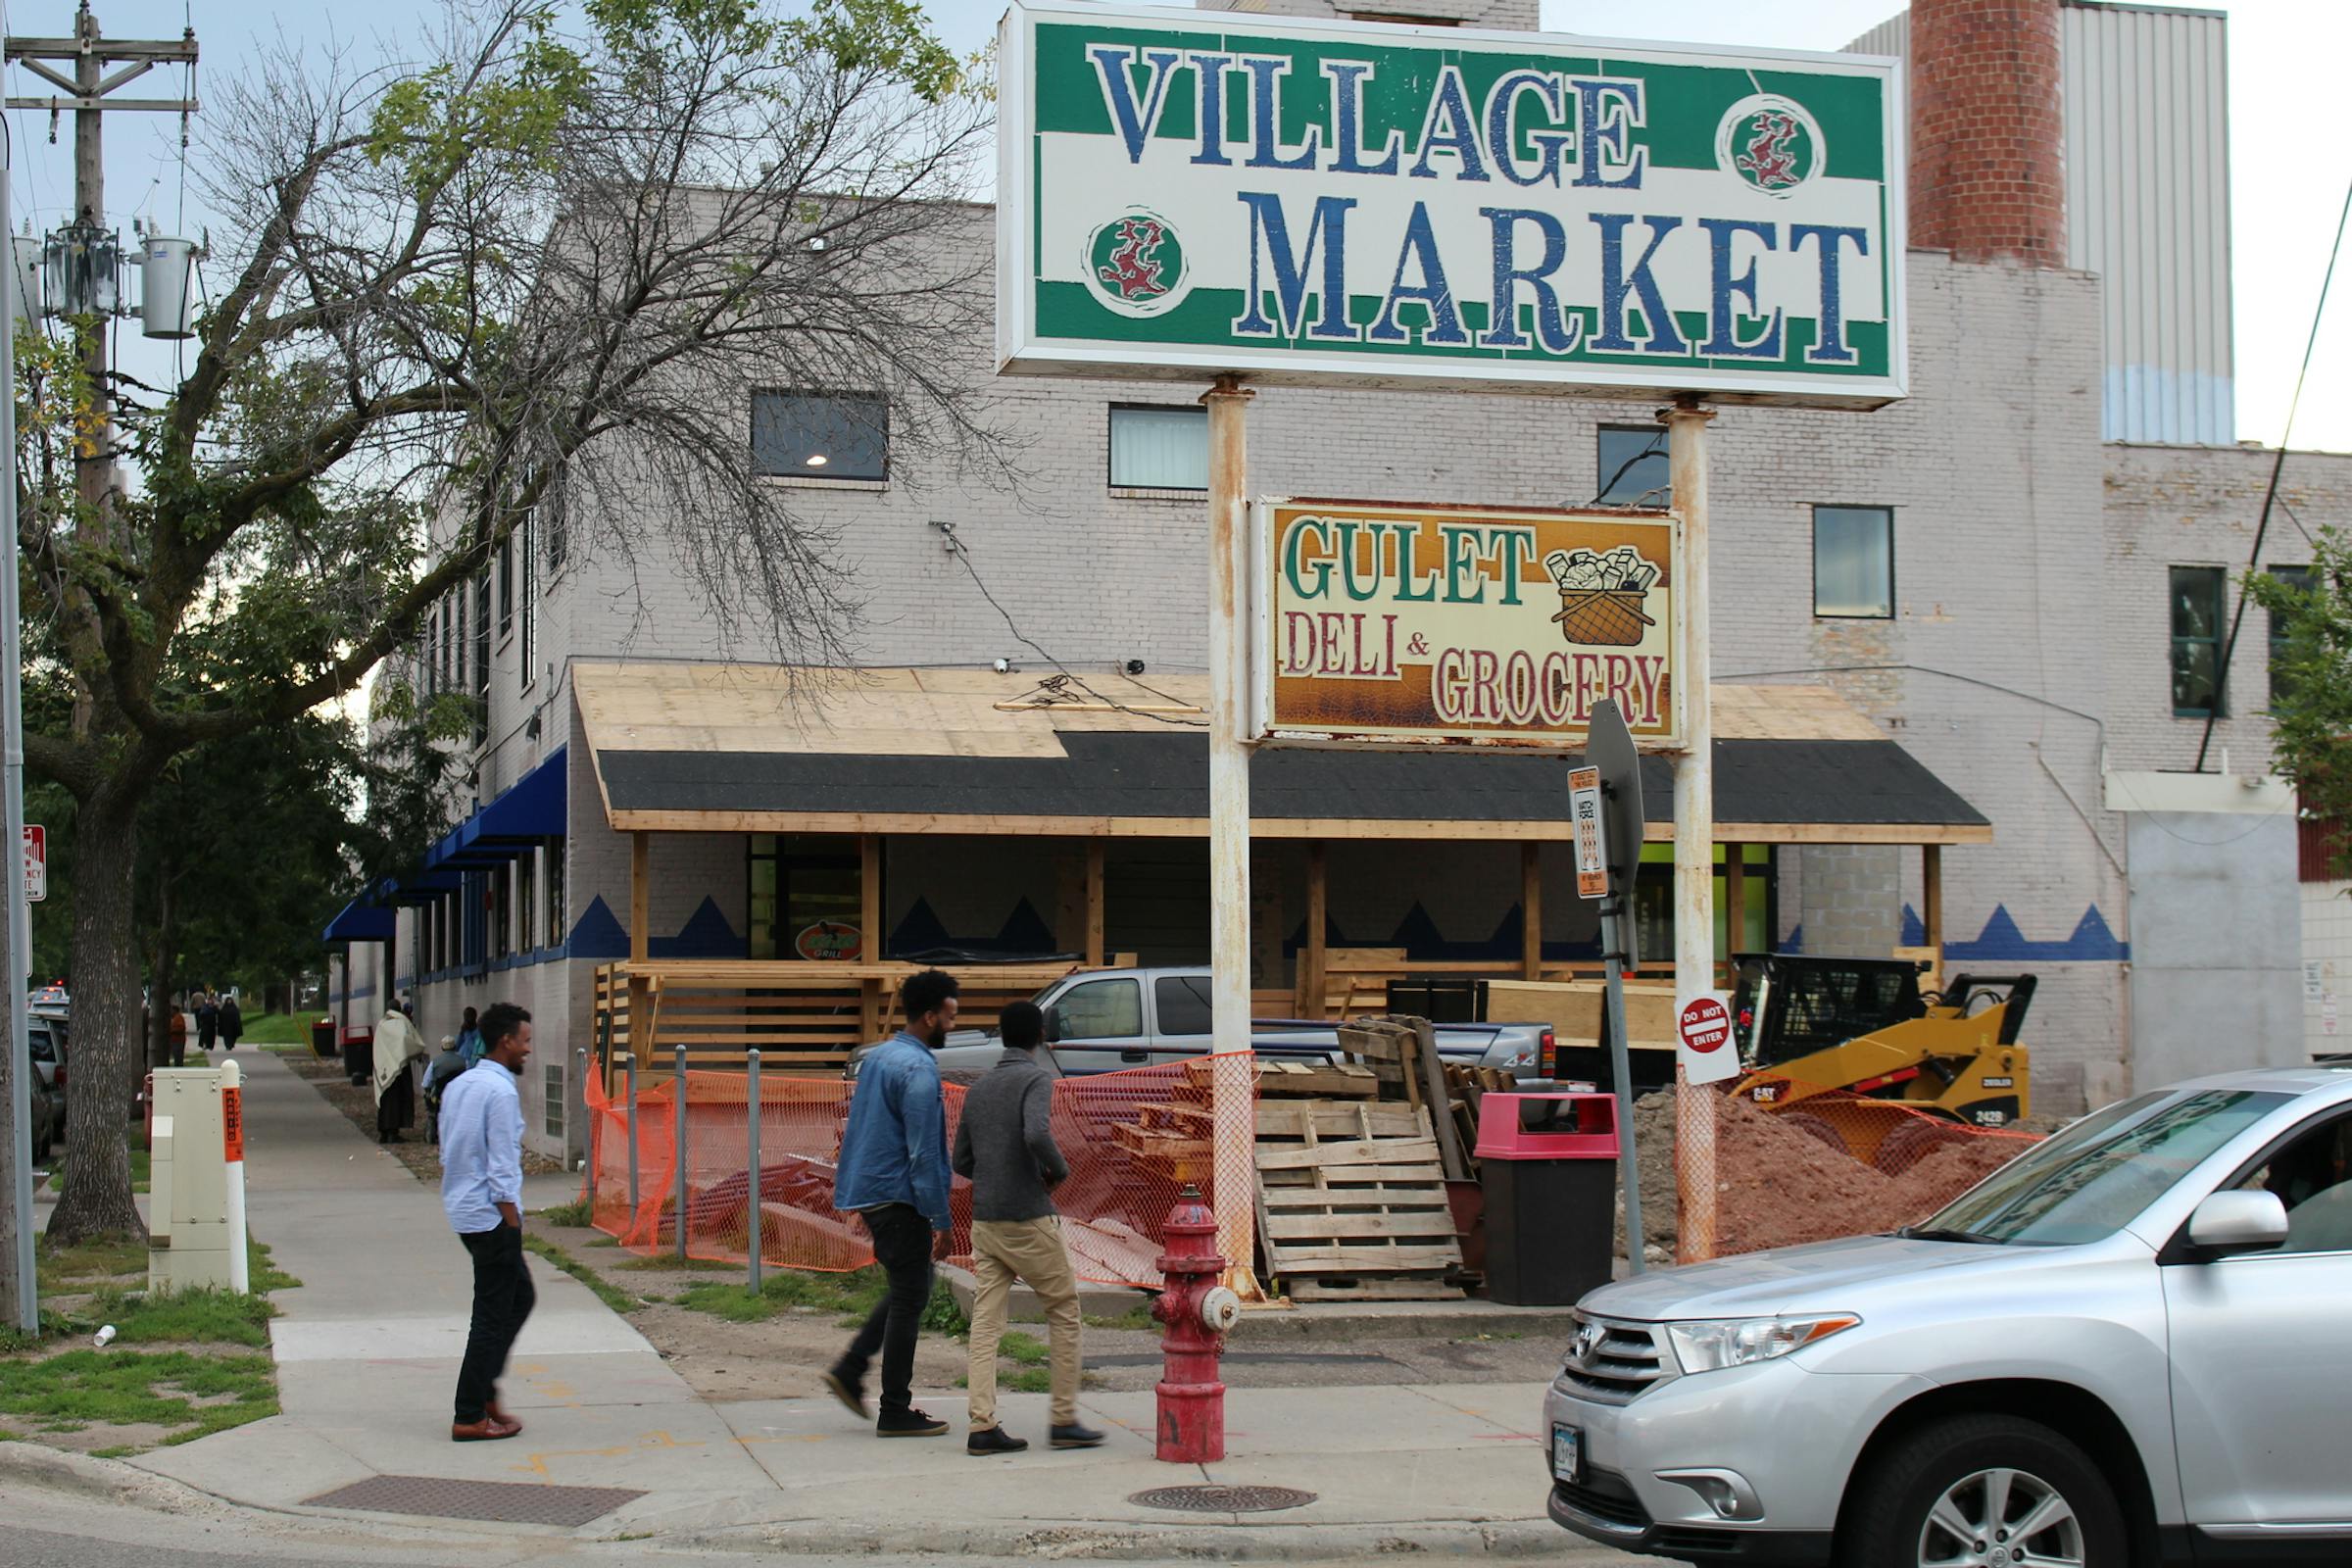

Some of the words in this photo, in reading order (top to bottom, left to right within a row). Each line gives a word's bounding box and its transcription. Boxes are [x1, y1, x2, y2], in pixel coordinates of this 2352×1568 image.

[1088, 44, 1648, 190] VILLAGE
[1233, 192, 1868, 365] MARKET
[1284, 518, 1535, 606] GULET
[1284, 611, 1399, 677] DELI
[1406, 631, 1430, 657] &
[1436, 648, 1664, 724] GROCERY
[814, 949, 842, 958] GRILL
[1683, 1011, 1698, 1023] DO
[1701, 1005, 1723, 1019] NOT
[1692, 1031, 1724, 1047] ENTER
[1753, 1087, 1776, 1102] CAT
